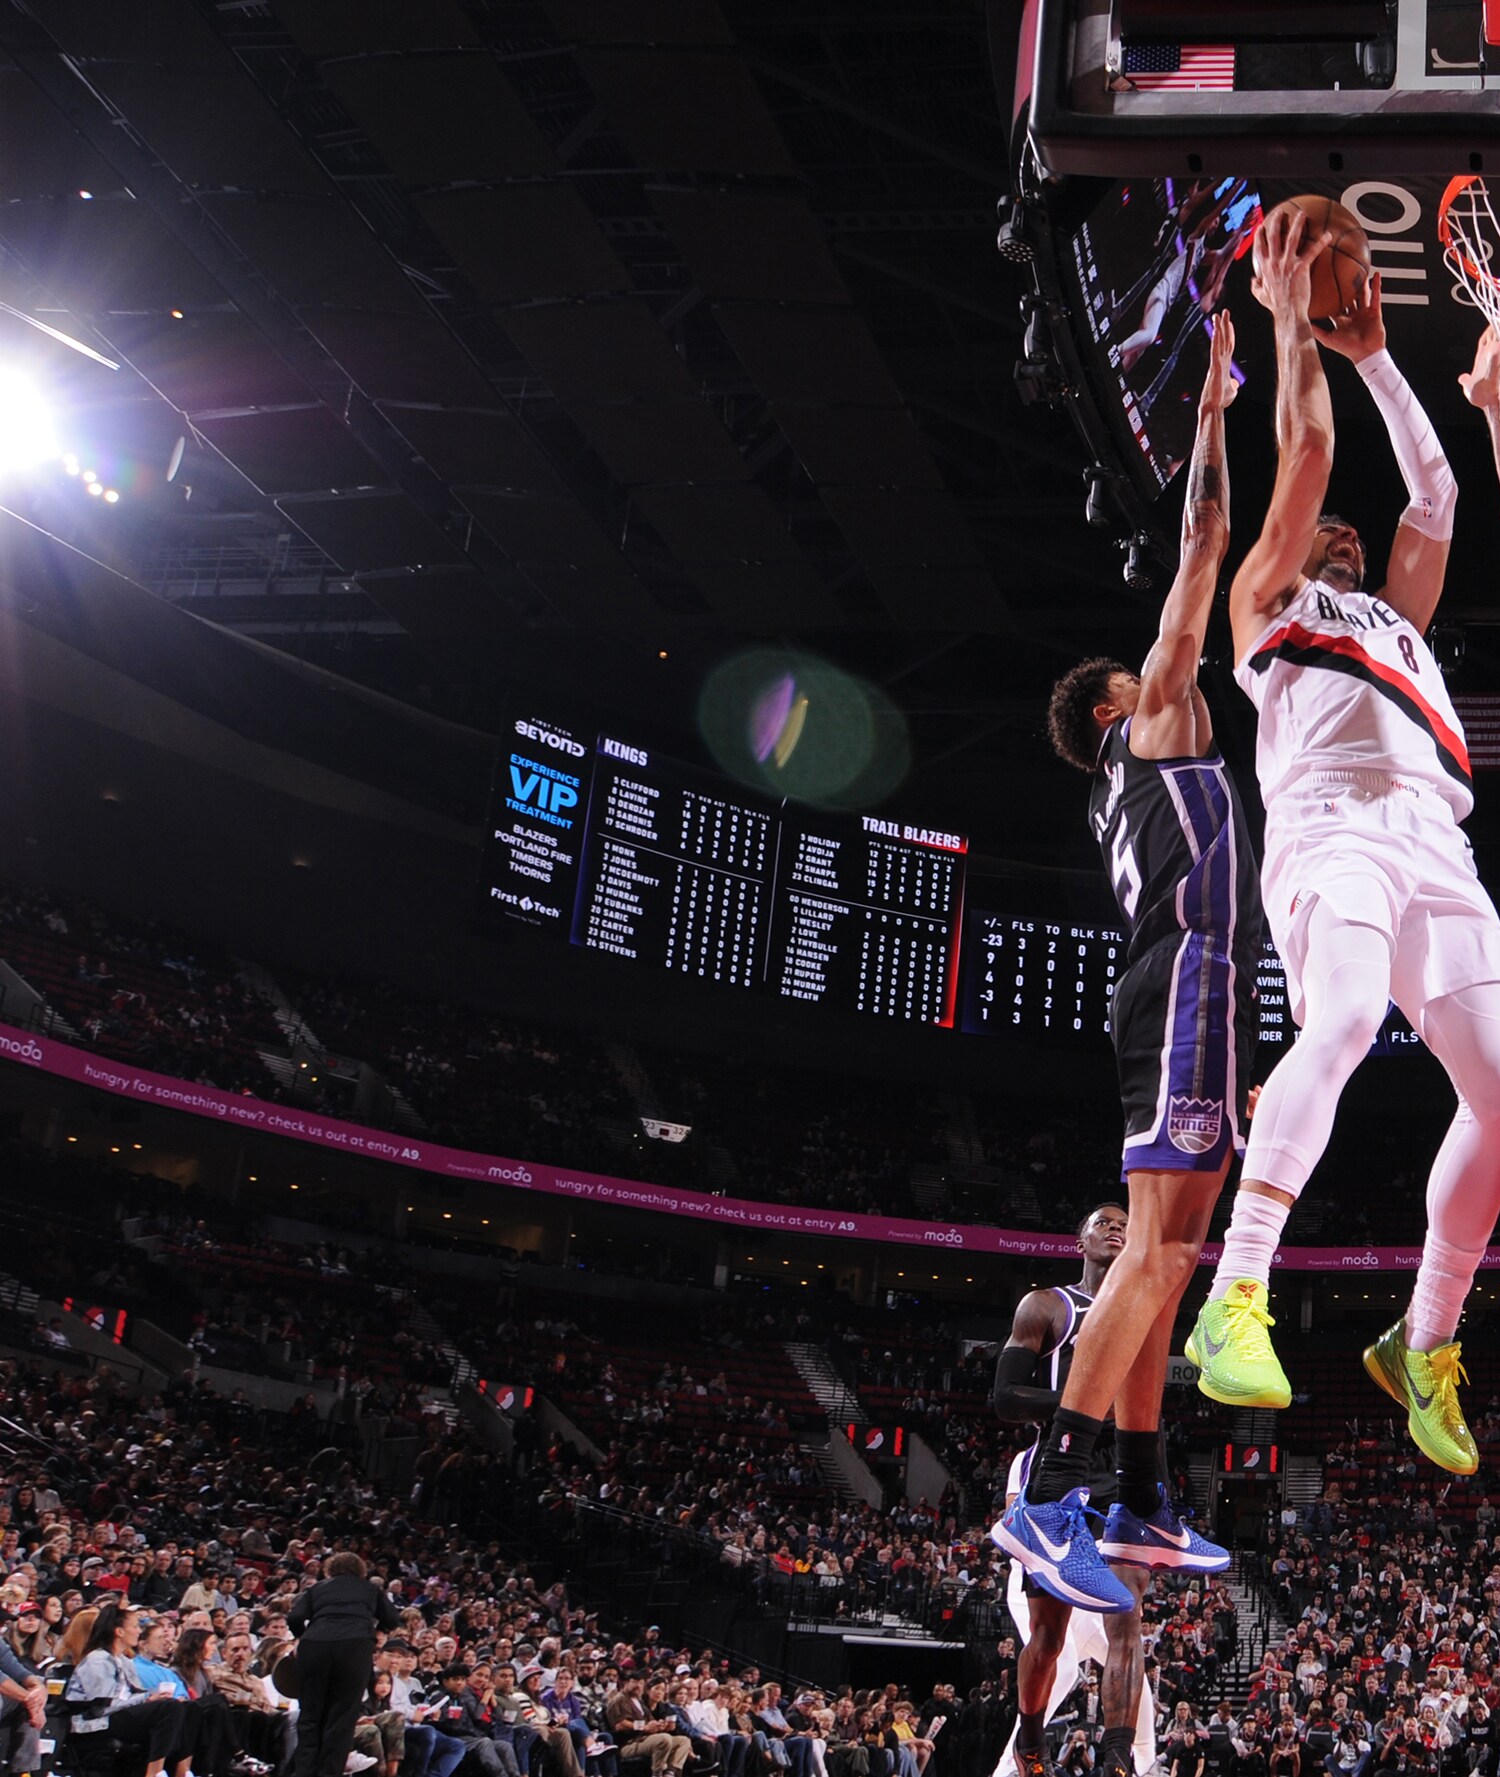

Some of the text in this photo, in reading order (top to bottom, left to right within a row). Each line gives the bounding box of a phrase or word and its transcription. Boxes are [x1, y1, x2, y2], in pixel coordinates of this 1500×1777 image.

[1397, 634, 1420, 675] 8
[531, 717, 572, 738] FIRST TECH
[603, 737, 649, 767] KINGS
[509, 753, 581, 788] EXPERIENCE
[508, 764, 579, 814] VIP
[619, 778, 660, 798] CLIFFORD
[1391, 779, 1420, 798] ripcity
[505, 796, 574, 830] TREATMENT
[512, 823, 558, 847] BLAZERS
[861, 816, 961, 850] TRAIL BLAZERS
[494, 830, 573, 865] PORTLAND FIRE
[510, 849, 554, 871] TIMBERS
[609, 852, 638, 870] JONES
[1112, 808, 1142, 919] 5
[508, 860, 552, 884] THORNS
[490, 887, 560, 918] First Tech
[599, 929, 625, 944] ELLIS
[982, 934, 1003, 947] -23
[1012, 921, 1124, 943] FLS TO BLK STL
[1391, 1031, 1419, 1043] FLS
[0, 1037, 43, 1061] moda
[84, 1064, 422, 1161] hungry for something new? check us out at entry A9.
[1170, 1119, 1218, 1133] KINGS
[488, 1165, 532, 1183] moda
[597, 1184, 858, 1232] for something new? check out at entry A9.
[924, 1228, 963, 1244] moda
[999, 1238, 1037, 1252] hungry
[1039, 1240, 1055, 1251] for
[1341, 1251, 1379, 1265] moda
